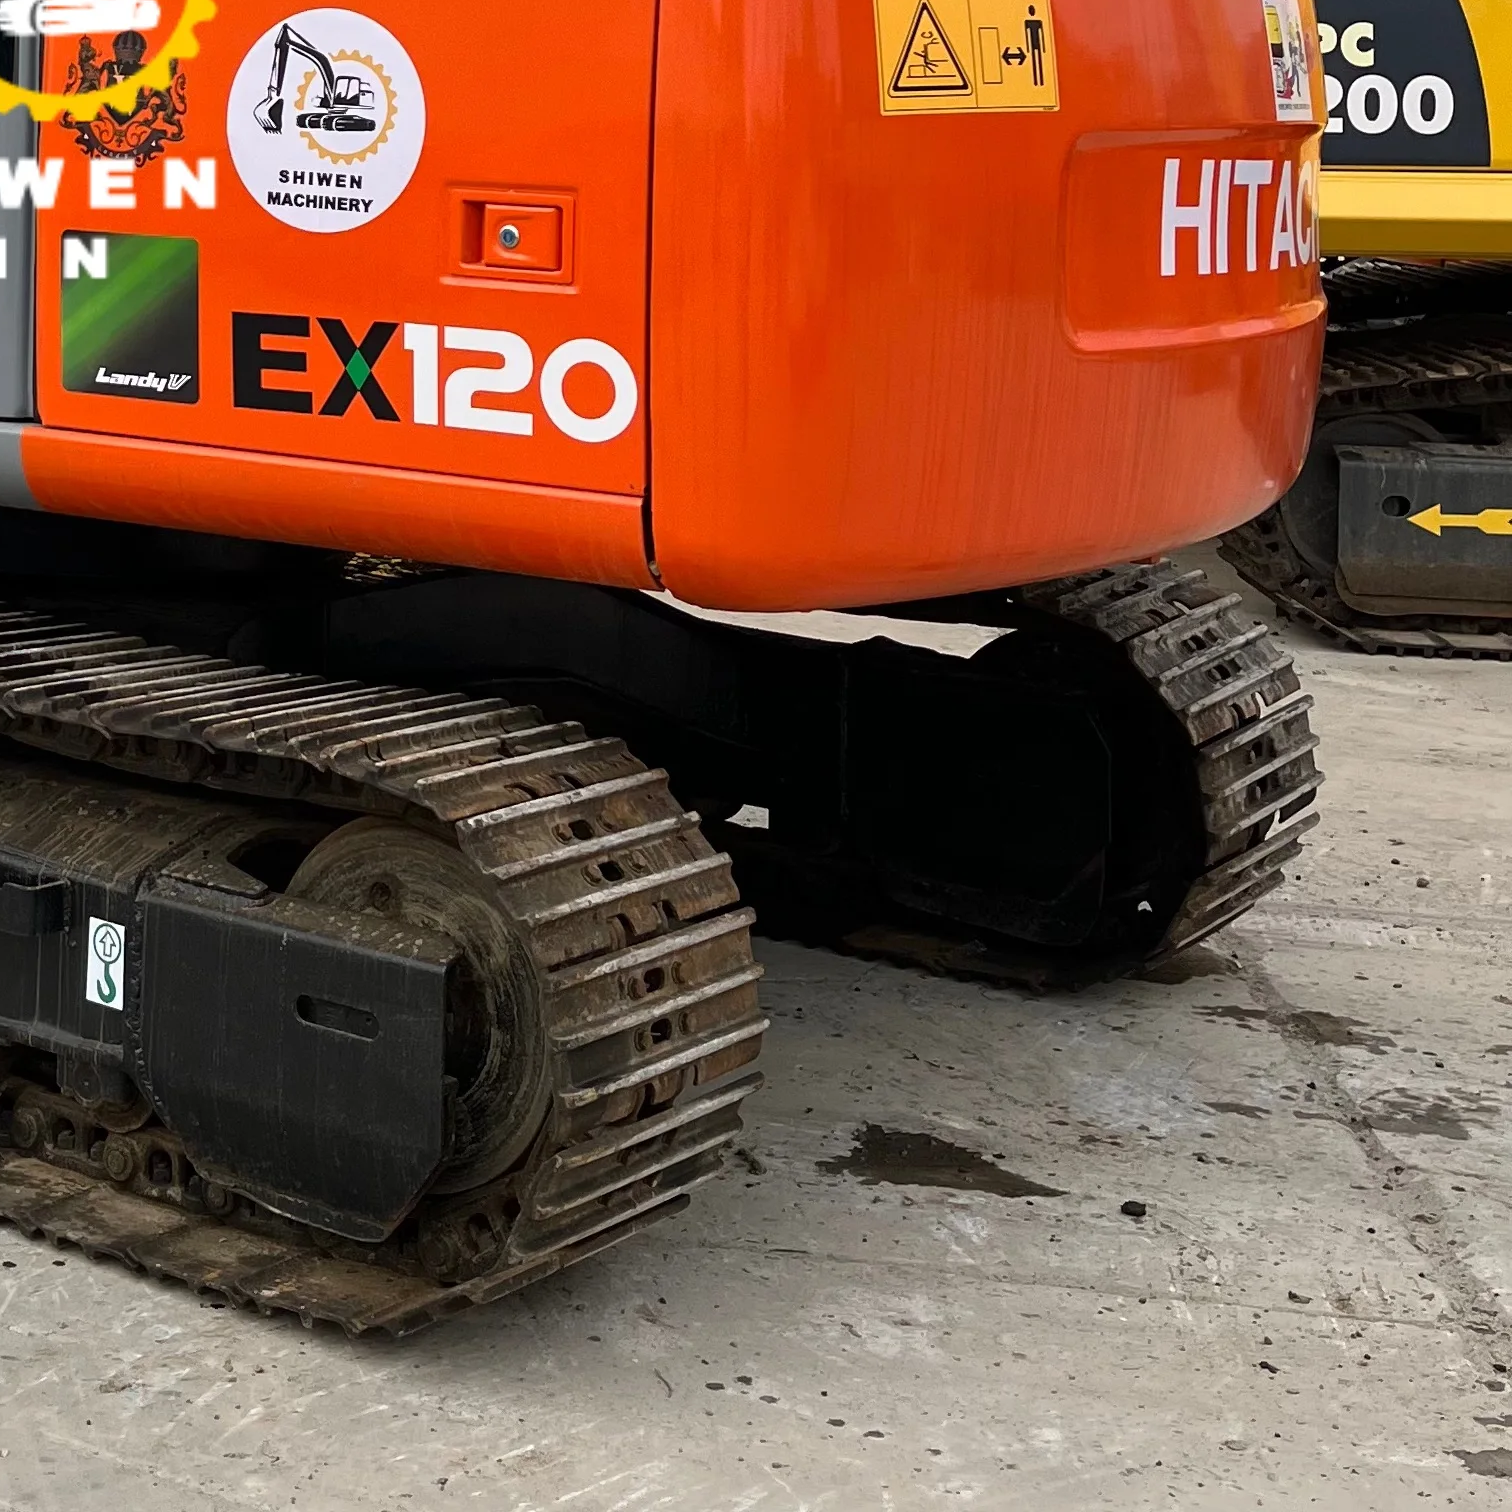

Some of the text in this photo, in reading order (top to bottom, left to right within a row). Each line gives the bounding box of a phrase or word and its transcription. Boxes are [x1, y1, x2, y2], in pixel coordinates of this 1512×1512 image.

[1317, 21, 1375, 67] PC
[1323, 74, 1455, 135] 200
[267, 191, 374, 213] MACHINERY
[278, 169, 363, 190] SHIWEN
[1160, 158, 1320, 277] HITACH
[232, 311, 639, 444] EX120
